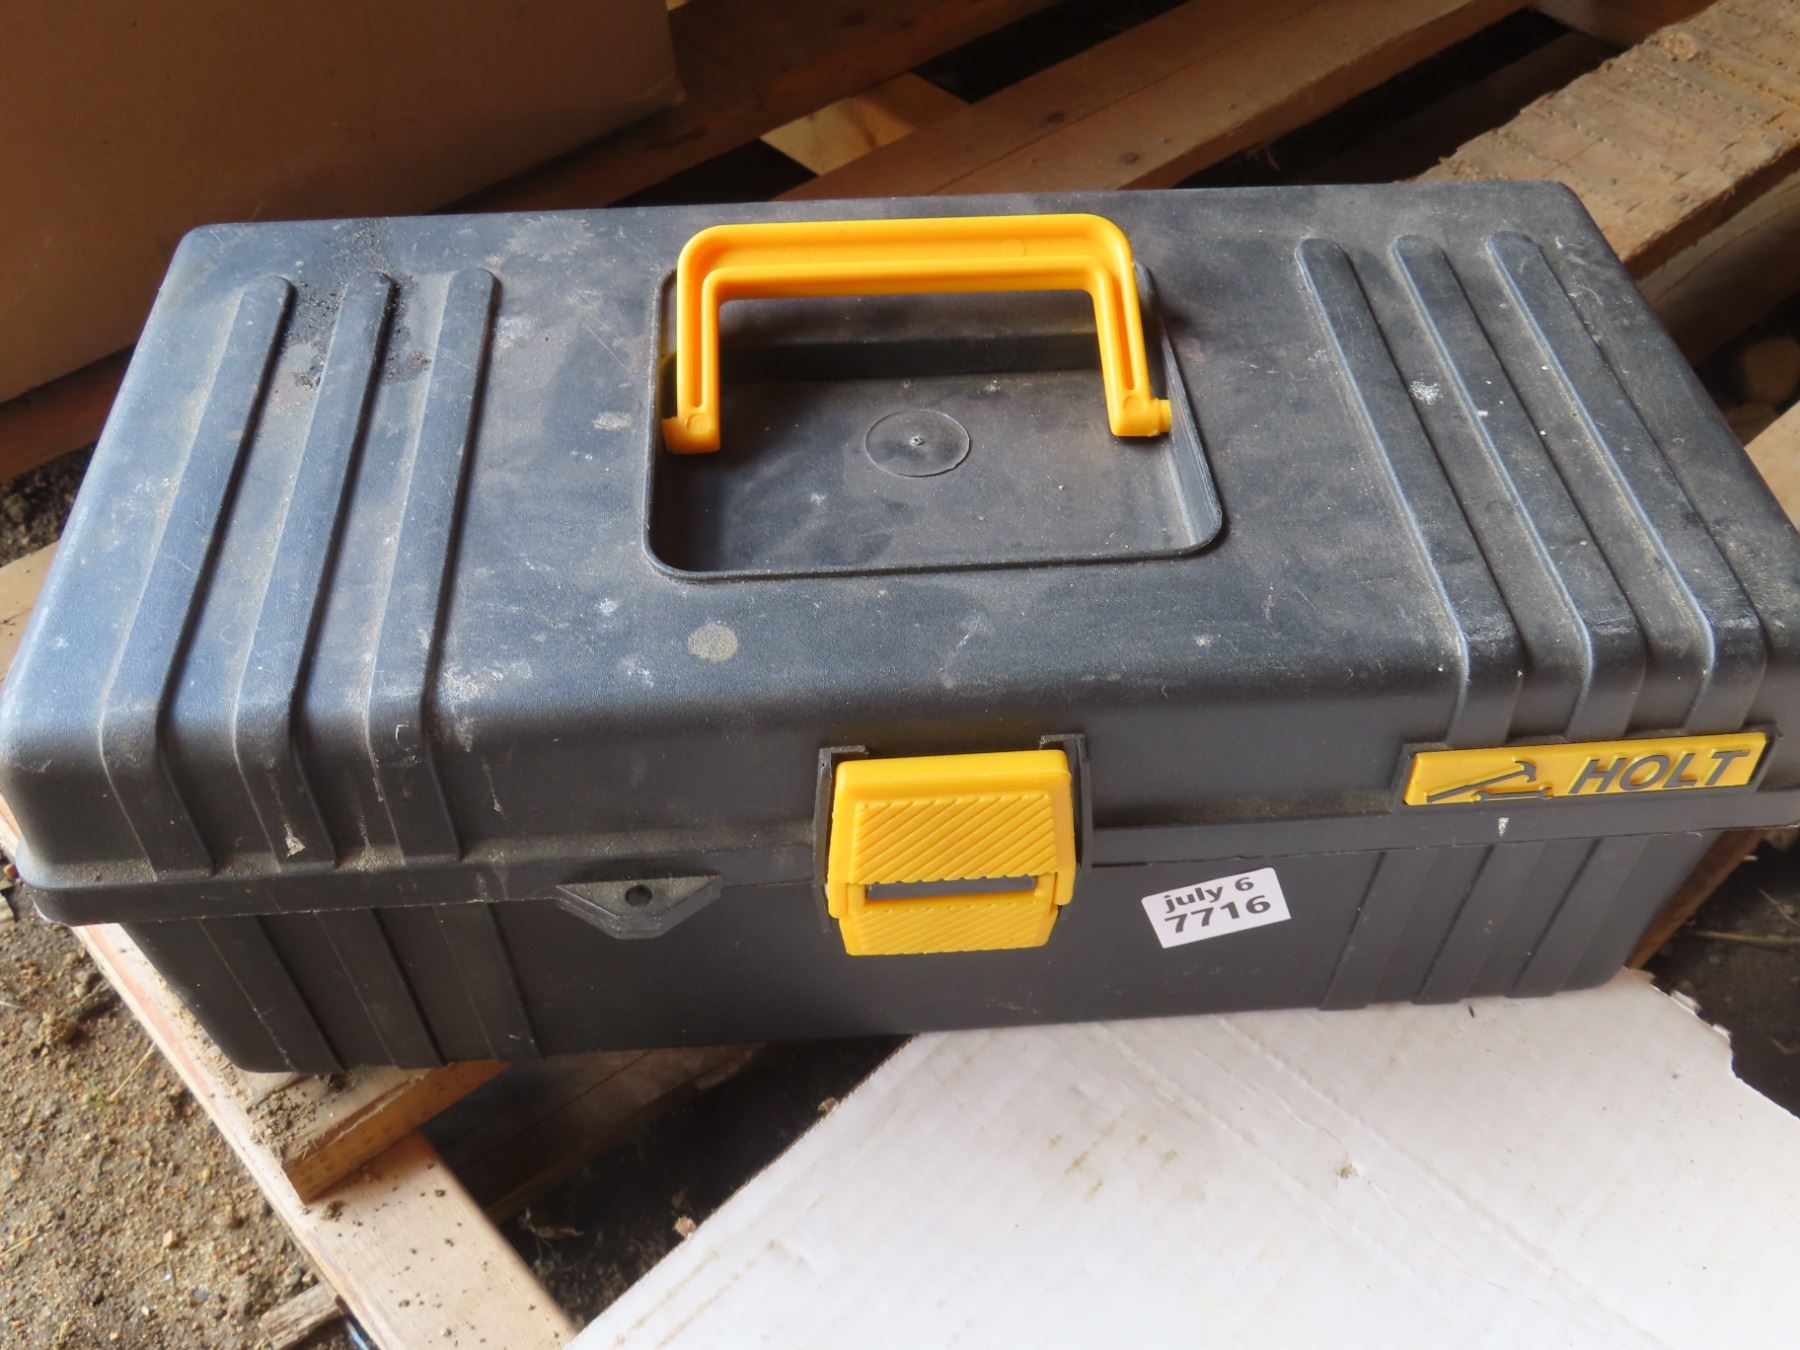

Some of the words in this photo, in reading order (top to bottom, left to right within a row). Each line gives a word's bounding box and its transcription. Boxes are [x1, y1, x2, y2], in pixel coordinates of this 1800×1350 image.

[1568, 749, 1751, 795] HOLT
[1163, 887, 1223, 914] july
[1234, 876, 1255, 892] 6
[1164, 895, 1272, 934] 7716
